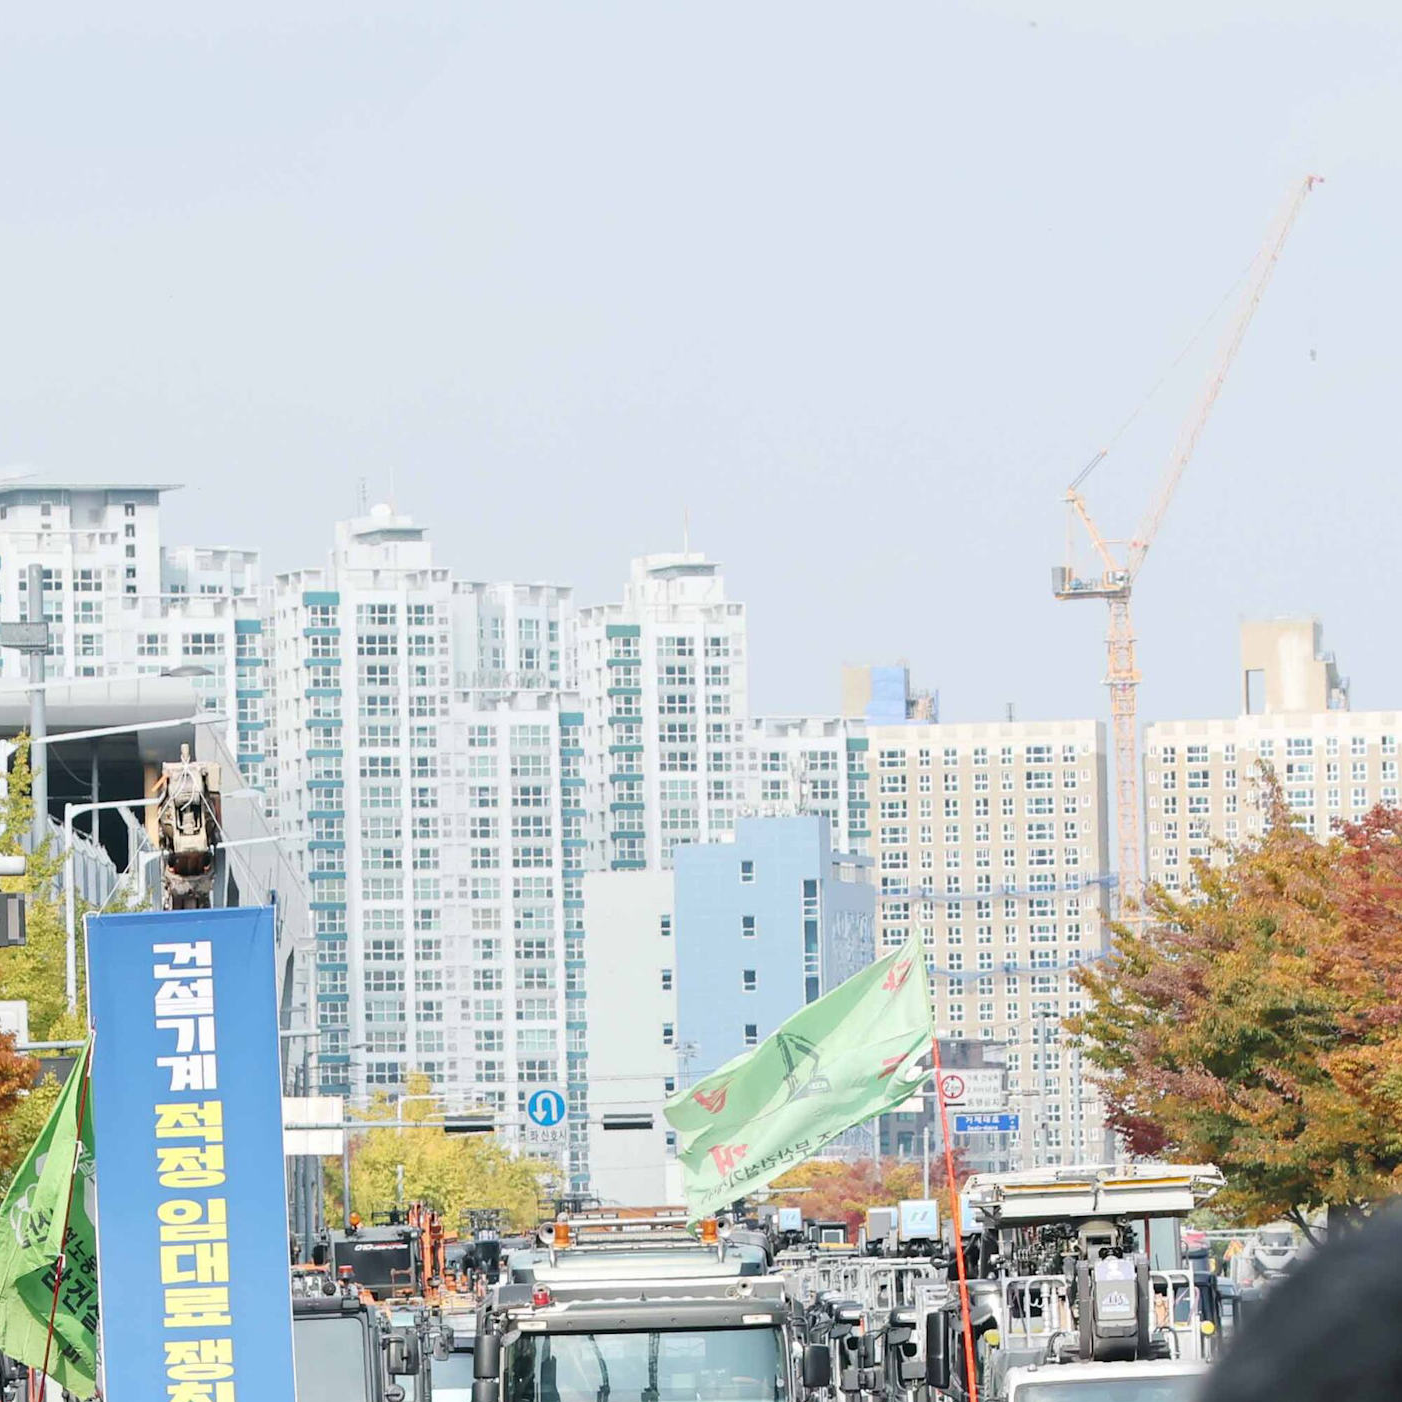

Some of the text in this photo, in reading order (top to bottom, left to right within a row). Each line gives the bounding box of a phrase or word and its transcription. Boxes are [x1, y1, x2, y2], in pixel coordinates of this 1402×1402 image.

[152, 941, 218, 1092] 건설기계
[154, 1101, 226, 1188] 적정
[156, 1198, 232, 1328] 임대료
